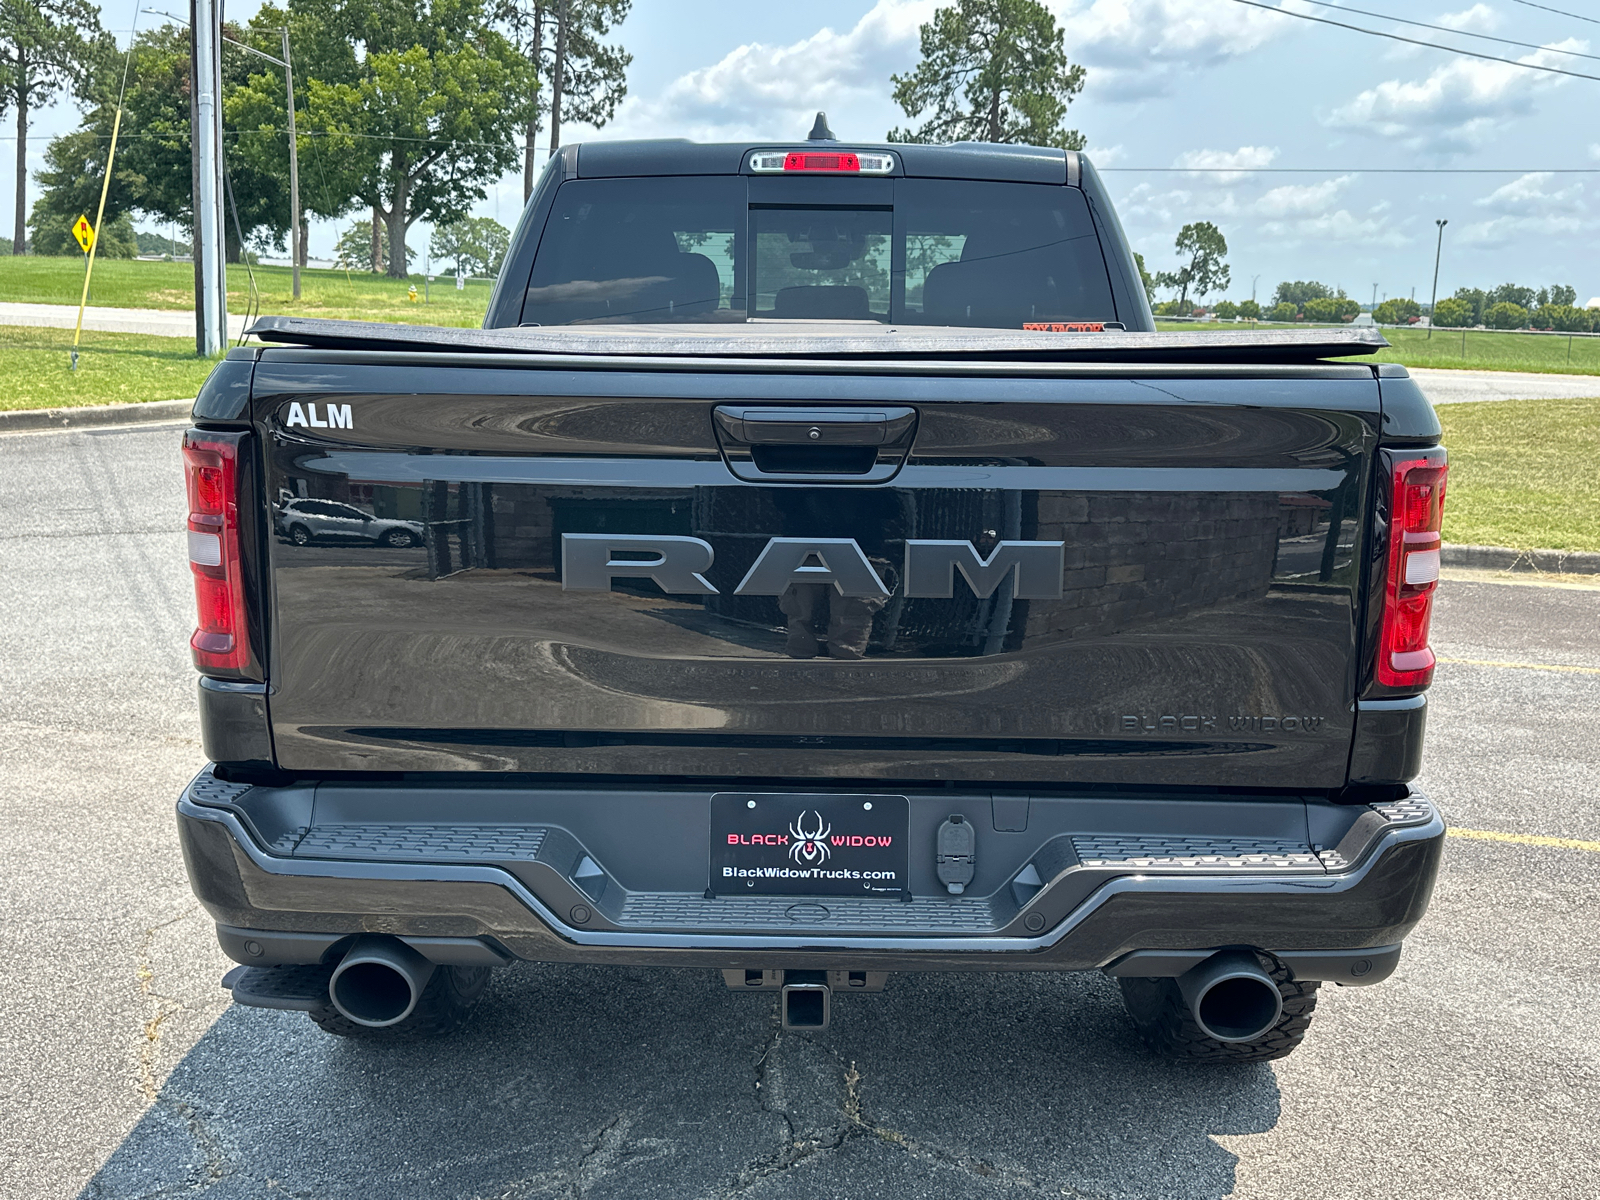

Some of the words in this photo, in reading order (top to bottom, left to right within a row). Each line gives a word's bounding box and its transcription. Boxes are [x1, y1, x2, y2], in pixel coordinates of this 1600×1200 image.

[1051, 324, 1104, 332] FACTOR
[286, 402, 353, 430] ALM
[561, 532, 1066, 600] RAM
[1121, 715, 1217, 731] BLACK
[1229, 716, 1325, 732] WIDOW
[727, 834, 789, 846] BLACK
[830, 835, 893, 847] WIDOW
[722, 867, 896, 880] BlackWidowTrucks.com
